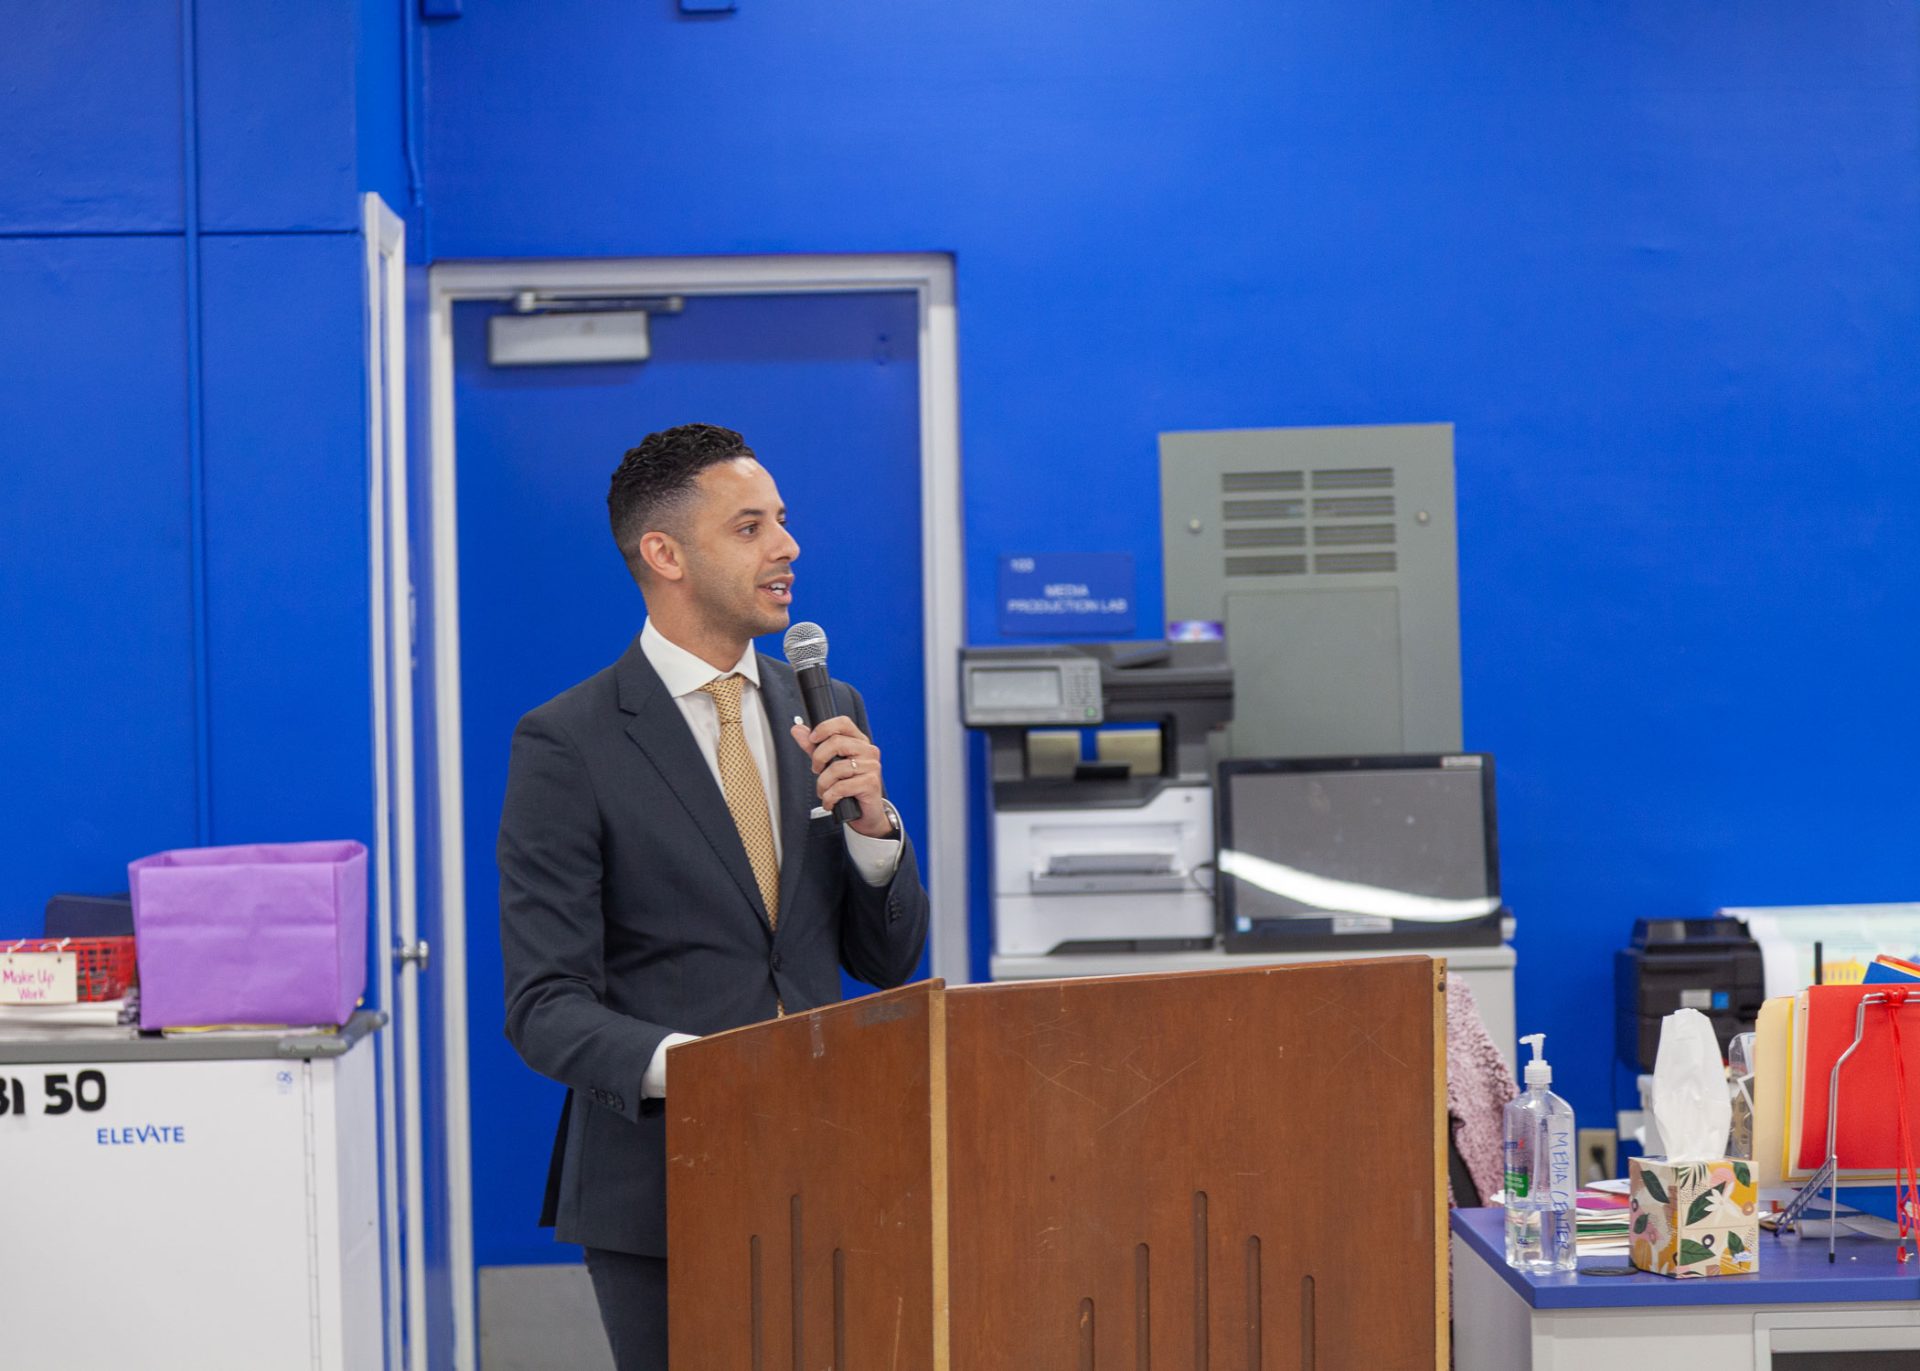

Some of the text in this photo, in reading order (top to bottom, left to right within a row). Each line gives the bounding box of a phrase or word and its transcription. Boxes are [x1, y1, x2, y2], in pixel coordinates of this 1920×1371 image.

[1044, 584, 1088, 597] MEDIA
[1006, 598, 1127, 614] PRODUCTION LAB
[3, 969, 54, 990] Make Up
[18, 987, 45, 1000] Work
[44, 1069, 107, 1115] 50
[97, 1124, 185, 1144] ELEVATE
[1550, 1132, 1571, 1250] MEDIA CENTER
